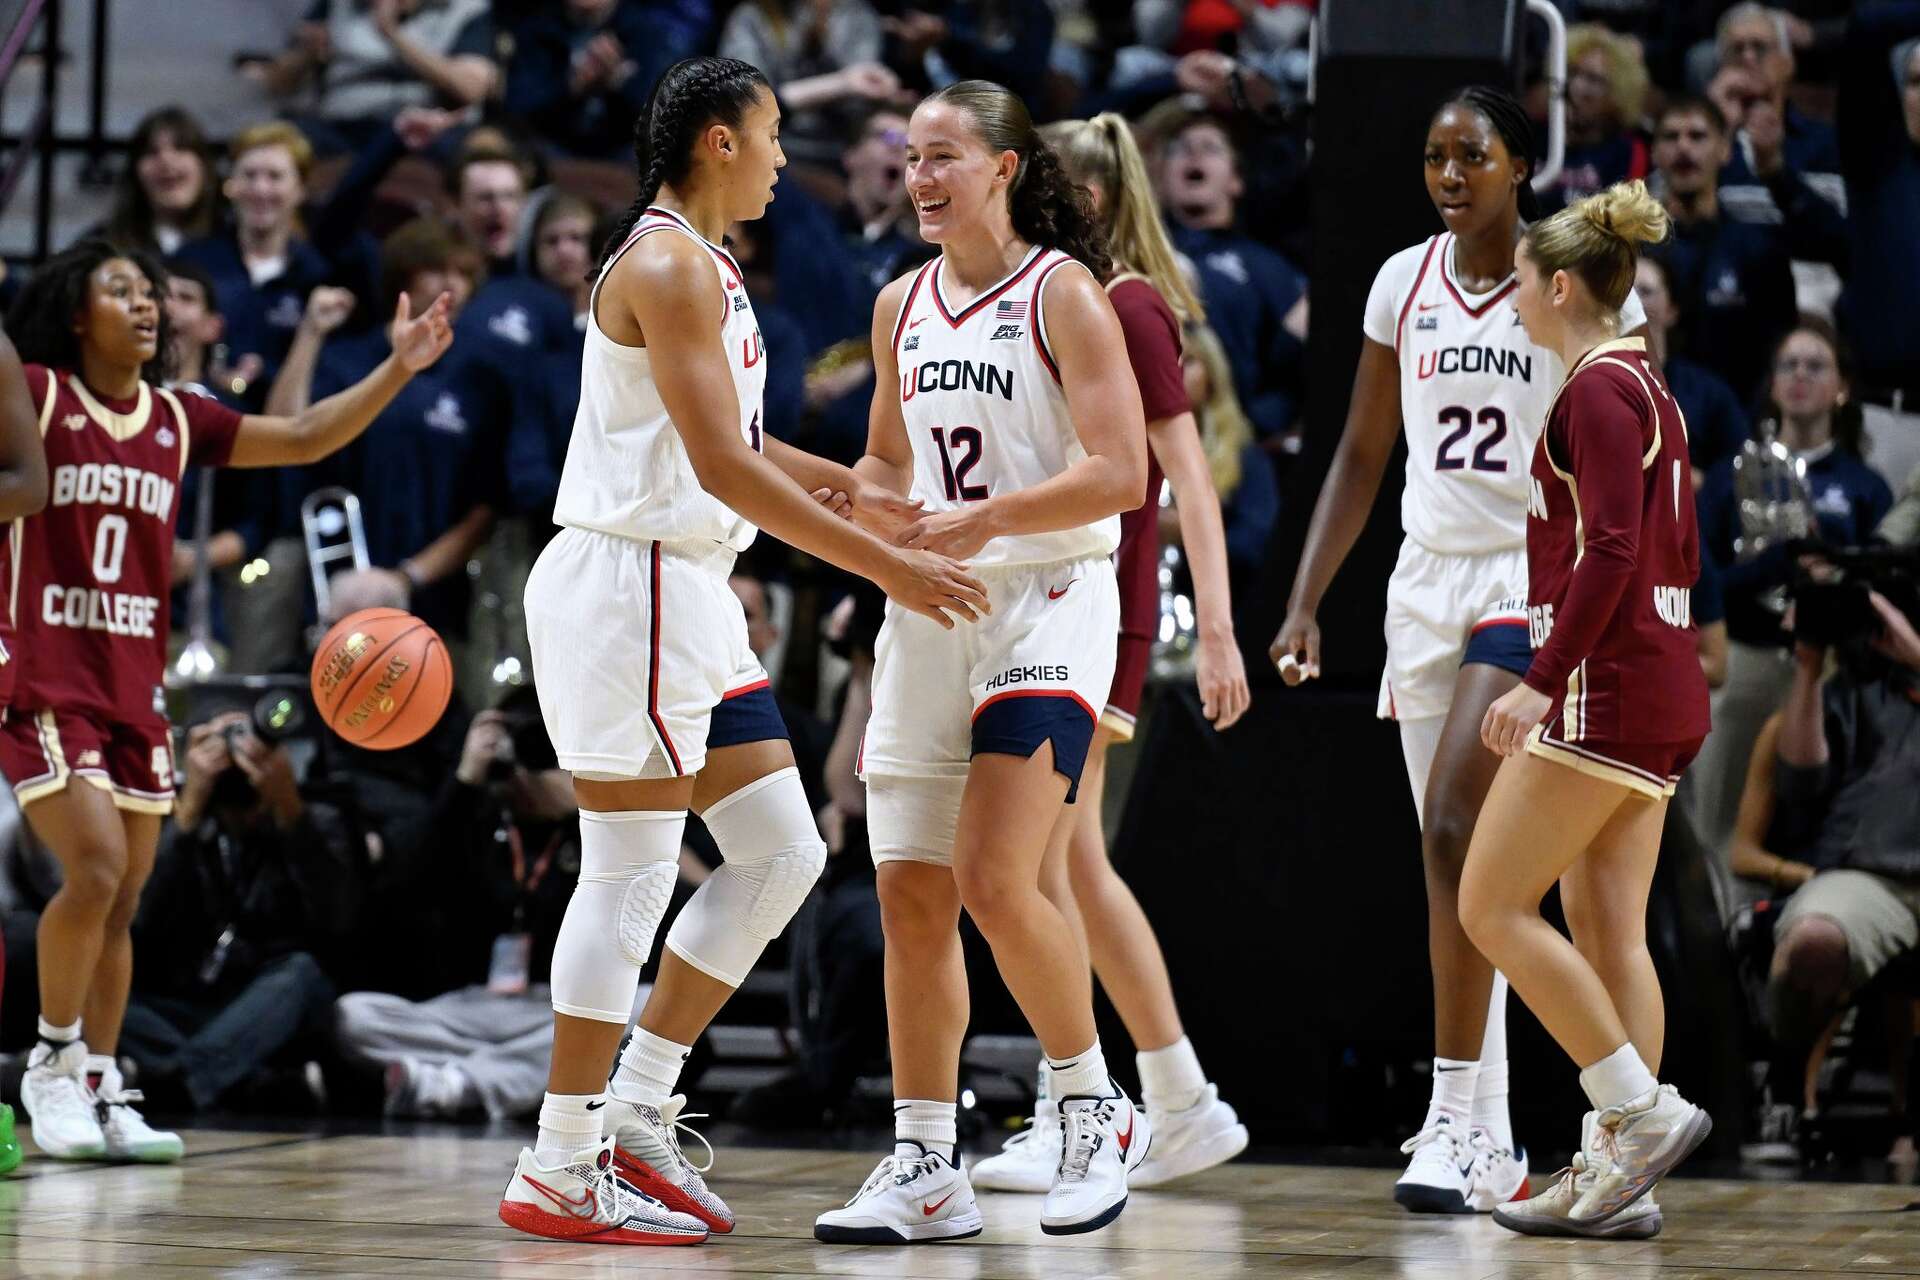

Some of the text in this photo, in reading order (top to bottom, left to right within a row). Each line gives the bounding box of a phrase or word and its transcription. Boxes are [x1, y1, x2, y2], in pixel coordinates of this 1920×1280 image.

[997, 324, 1020, 332] BIG
[902, 359, 1014, 402] UCONN
[1417, 345, 1532, 384] UCONN
[930, 426, 989, 502] 12
[1434, 405, 1508, 473] 22
[53, 463, 175, 524] BOSTON
[92, 513, 129, 583] 0
[42, 584, 160, 639] COLLEGE
[985, 665, 1069, 692] HUSKIES
